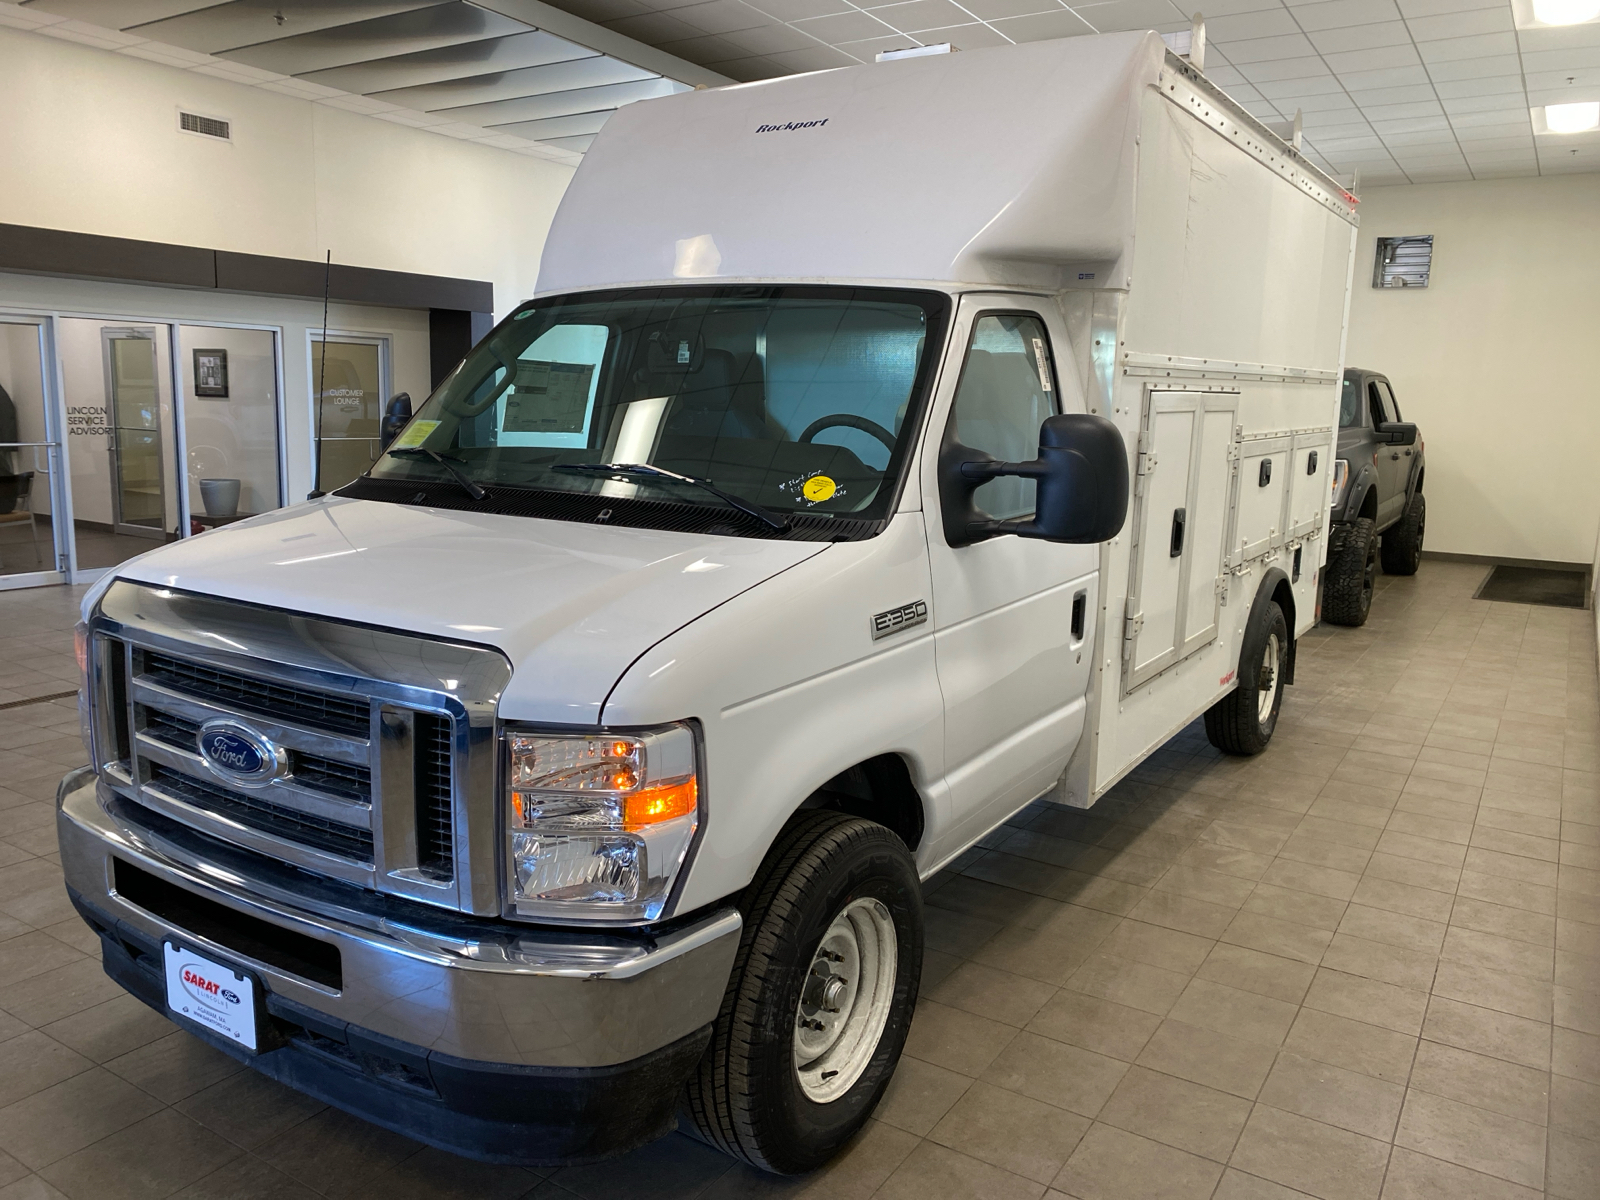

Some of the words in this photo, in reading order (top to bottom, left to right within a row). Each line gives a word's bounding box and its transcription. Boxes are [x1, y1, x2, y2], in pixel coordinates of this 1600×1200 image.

[755, 117, 830, 134] Rockport
[330, 389, 364, 397] CUSTOMER
[333, 397, 360, 405] LOUNGE
[67, 406, 107, 415] LINCOLN
[67, 416, 105, 425] SERVICE
[874, 601, 927, 632] E-350
[210, 736, 248, 768] Ford
[183, 969, 221, 995] SARAT
